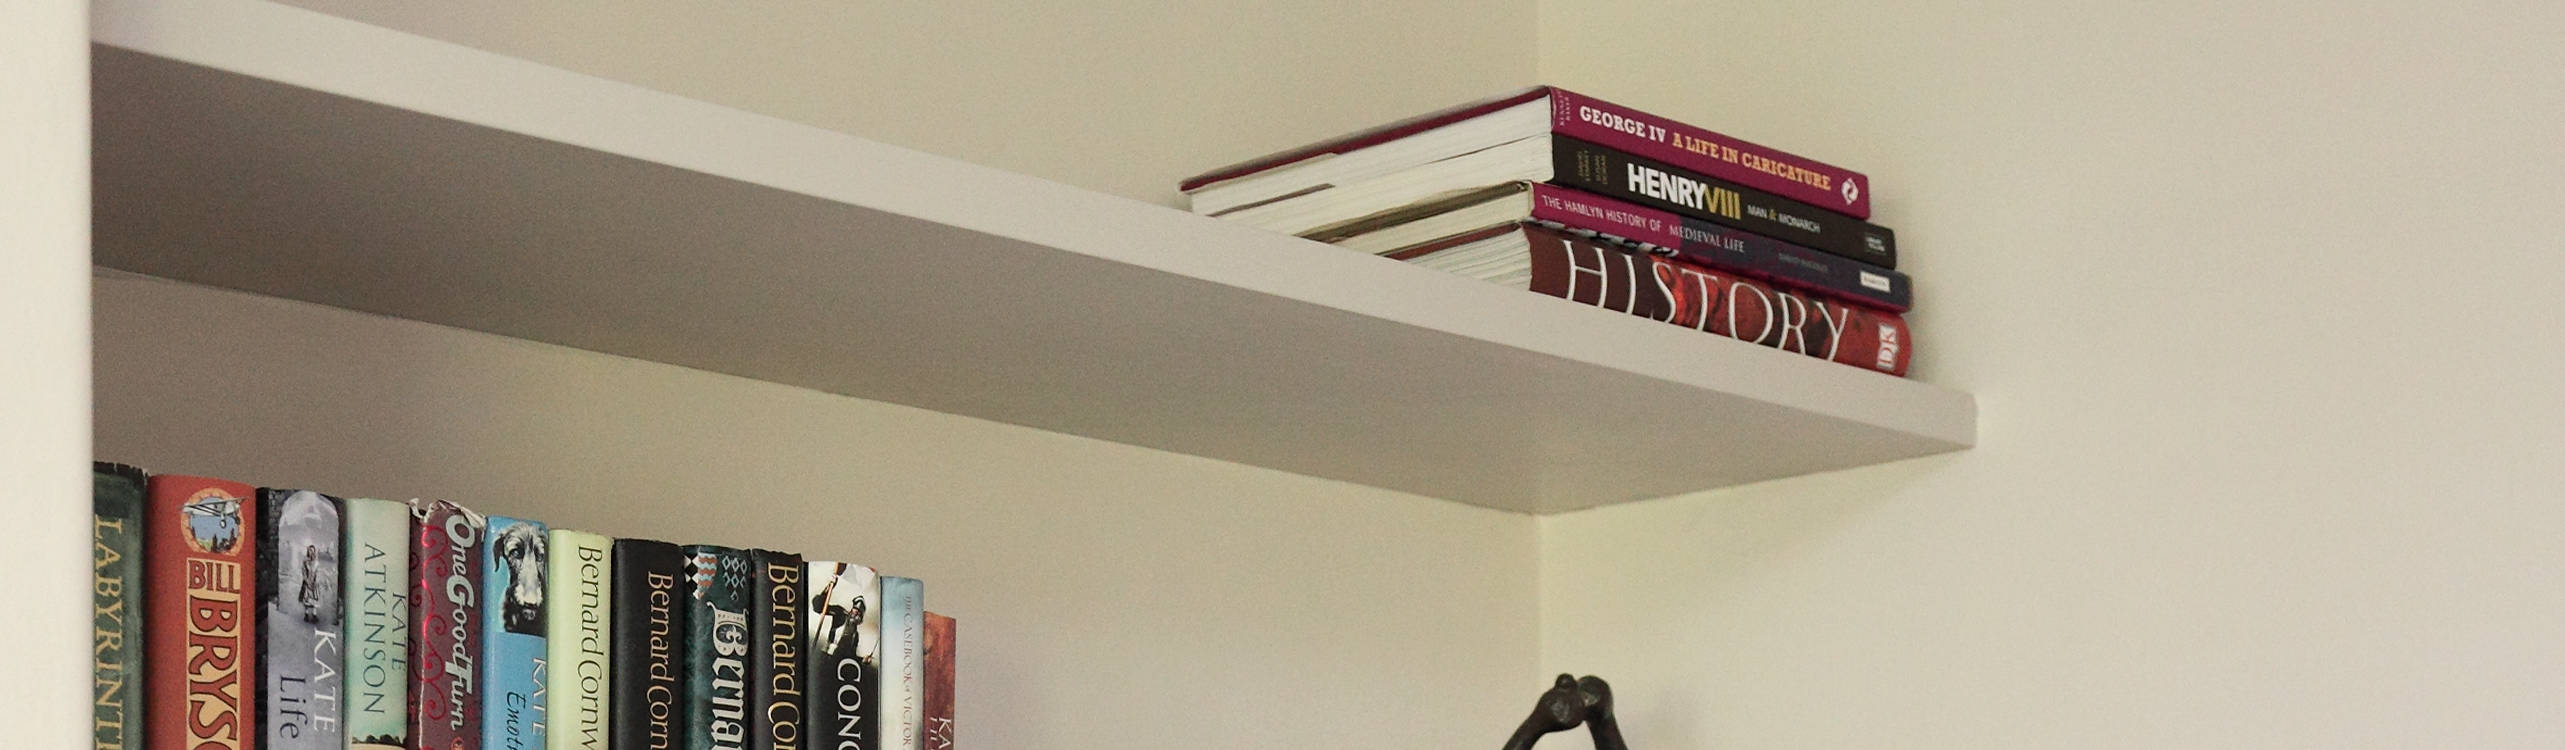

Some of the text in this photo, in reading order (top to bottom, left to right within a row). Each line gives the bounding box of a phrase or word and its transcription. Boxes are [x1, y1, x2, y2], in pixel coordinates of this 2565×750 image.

[1580, 105, 1831, 191] GEORGE IV A LIFE IN CARICATURE
[1541, 195, 1745, 253] THE HAMLYN HISTORY OF MEDIEVAL LIFE
[1747, 204, 1767, 219] MAN
[1769, 209, 1777, 222] &
[1779, 213, 1821, 233] MONARCH
[1562, 239, 1848, 362] HISTORY
[1878, 325, 1898, 367] DK
[188, 559, 240, 594] BILL
[577, 545, 604, 656] Bernard
[363, 542, 386, 714] ATKINSON
[391, 592, 407, 671] KATE
[648, 570, 675, 682] Bernard
[767, 561, 801, 696] Bernard
[903, 612, 912, 683] CASEBOOK
[280, 674, 308, 739] Life
[313, 628, 337, 733] KATE
[902, 695, 912, 746] VICTOR
[938, 717, 952, 749] KA
